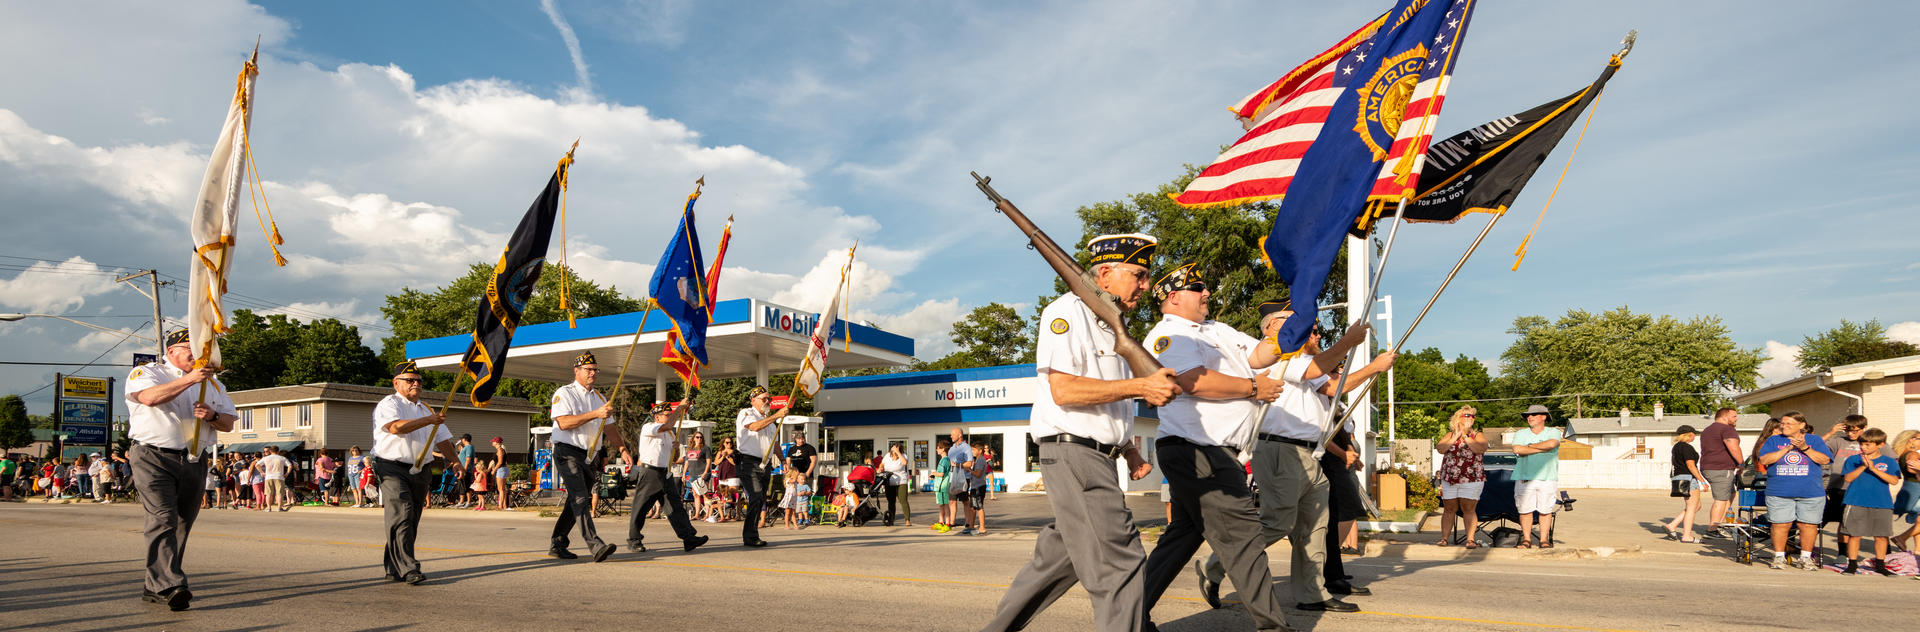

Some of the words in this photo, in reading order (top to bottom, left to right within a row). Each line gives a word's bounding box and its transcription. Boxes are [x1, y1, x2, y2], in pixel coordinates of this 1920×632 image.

[765, 306, 812, 337] Mobil
[68, 379, 102, 387] Weichert
[935, 387, 970, 401] Mobil
[975, 386, 1006, 399] Mart
